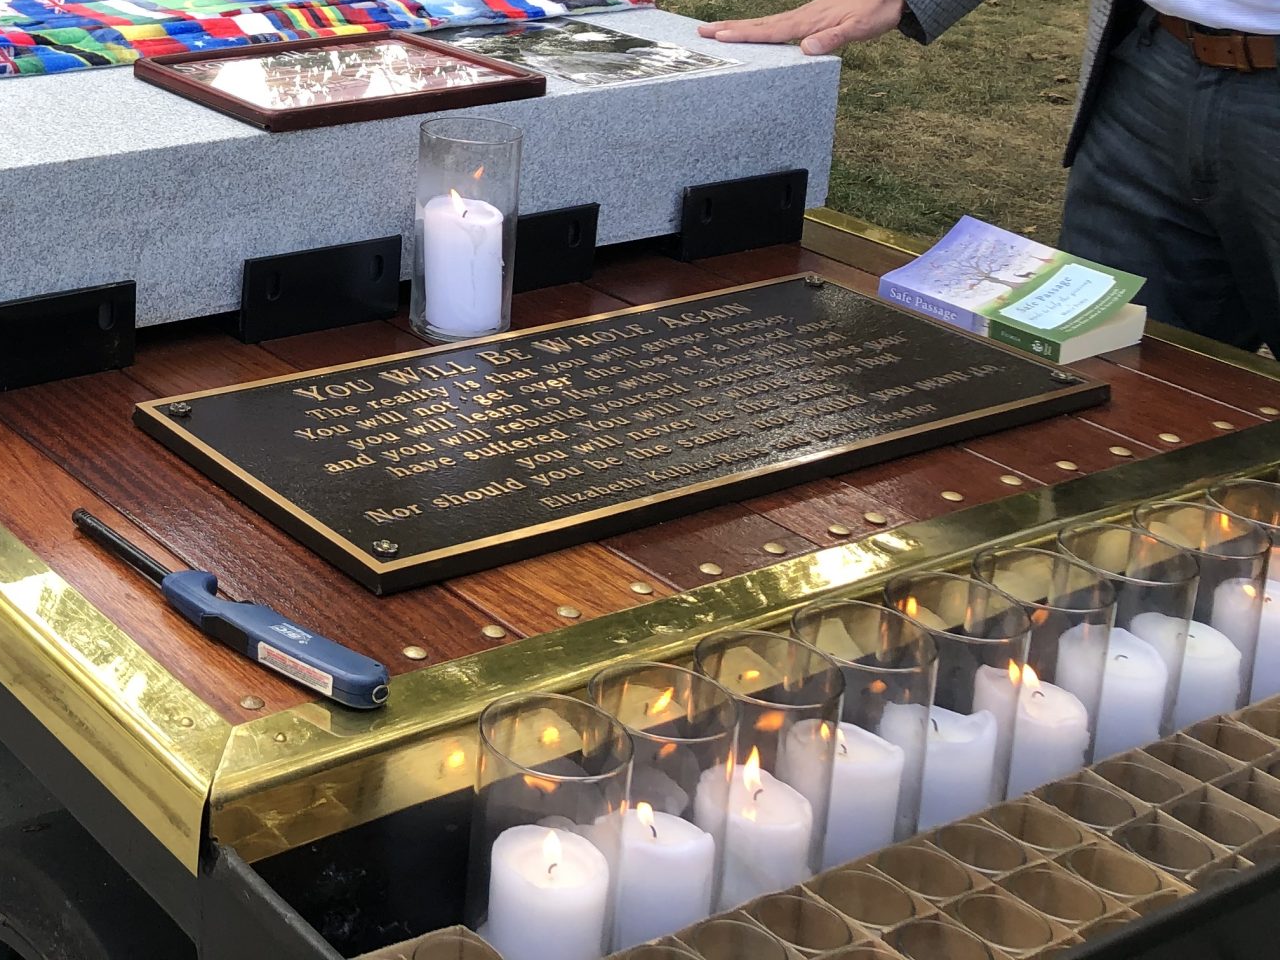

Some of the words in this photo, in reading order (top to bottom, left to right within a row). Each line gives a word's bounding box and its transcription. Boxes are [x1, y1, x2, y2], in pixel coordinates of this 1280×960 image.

[293, 379, 375, 401] YOU
[378, 360, 476, 385] WILL
[476, 348, 532, 367] BE
[532, 323, 655, 354] WHOLE
[658, 303, 752, 329] AGAIN
[889, 287, 912, 305] Safe
[914, 296, 958, 321] Passage
[294, 422, 351, 441] You
[355, 409, 408, 431] will
[412, 399, 459, 418] not
[584, 362, 626, 381] the
[625, 352, 678, 370] loss
[684, 344, 708, 359] of
[712, 342, 730, 353] a
[728, 327, 792, 348] loved
[305, 403, 361, 421] The
[367, 383, 450, 409] reality
[455, 378, 481, 392] is
[486, 367, 539, 384] that
[541, 356, 588, 374] you
[590, 345, 636, 363] will
[641, 331, 709, 353] grieve
[324, 452, 377, 475] and
[381, 440, 436, 463] you
[439, 427, 492, 448] will
[494, 406, 587, 435] rebuild
[590, 383, 691, 415] yourself
[693, 363, 774, 389] around
[774, 355, 816, 370] the
[812, 344, 863, 360] loss
[347, 429, 401, 451] you
[404, 417, 458, 438] will
[459, 401, 528, 424] learn
[532, 394, 561, 409] to
[562, 382, 614, 401] live
[617, 371, 671, 390] with
[703, 354, 752, 369] You
[750, 342, 797, 359] will
[365, 502, 423, 525] Nor
[431, 477, 527, 510] should
[530, 463, 585, 488] you
[583, 452, 624, 471] be
[625, 442, 673, 461] the
[751, 413, 794, 430] nor
[796, 394, 869, 417] would
[869, 385, 915, 403] you
[385, 454, 457, 479] have
[463, 427, 577, 461] suffered.
[577, 415, 631, 434] You
[634, 402, 683, 422] will
[683, 393, 718, 410] be
[719, 377, 790, 400] whole
[515, 448, 569, 471] you
[573, 434, 623, 455] will
[626, 416, 697, 442] never
[698, 407, 735, 424] be
[735, 398, 779, 415] the
[539, 475, 645, 510] Elizabeth
[774, 435, 811, 450] and
